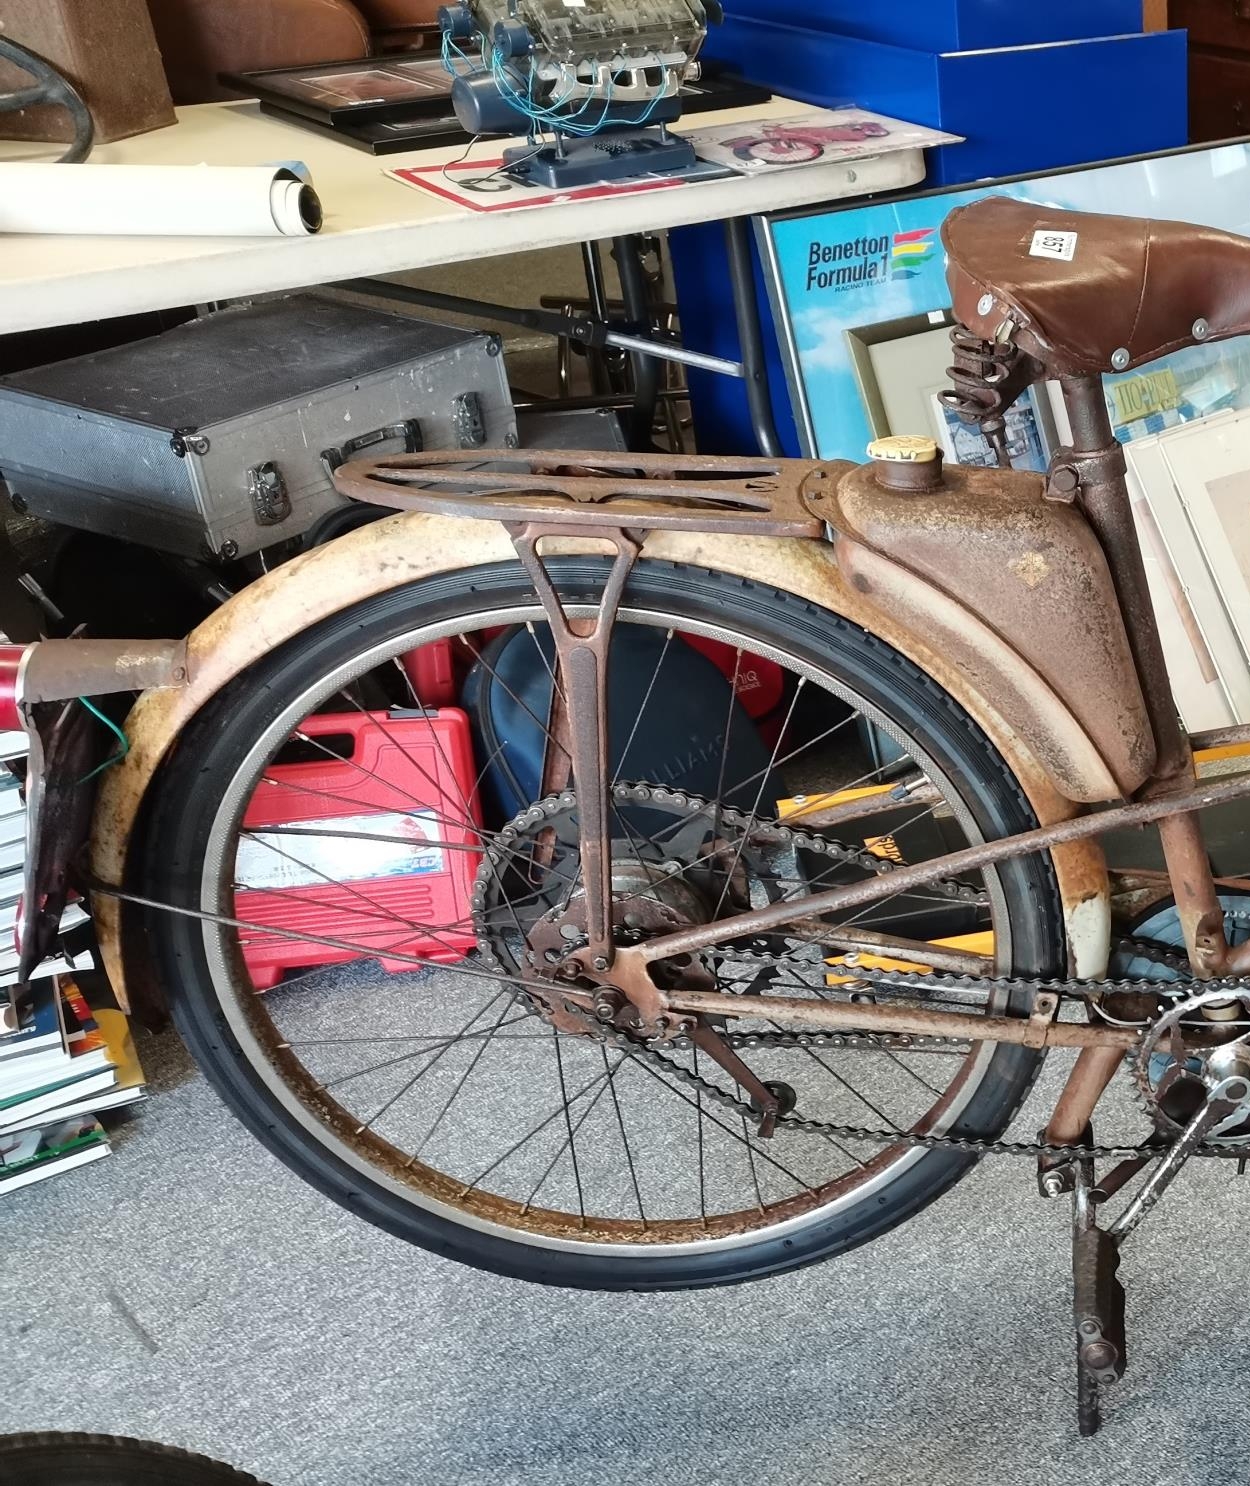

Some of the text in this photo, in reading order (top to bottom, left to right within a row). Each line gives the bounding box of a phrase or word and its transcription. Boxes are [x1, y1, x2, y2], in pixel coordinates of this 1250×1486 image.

[808, 235, 888, 266] Benetton
[1041, 236, 1064, 252] 857
[806, 253, 888, 291] Formula 1
[834, 278, 887, 292] RACING TEAM
